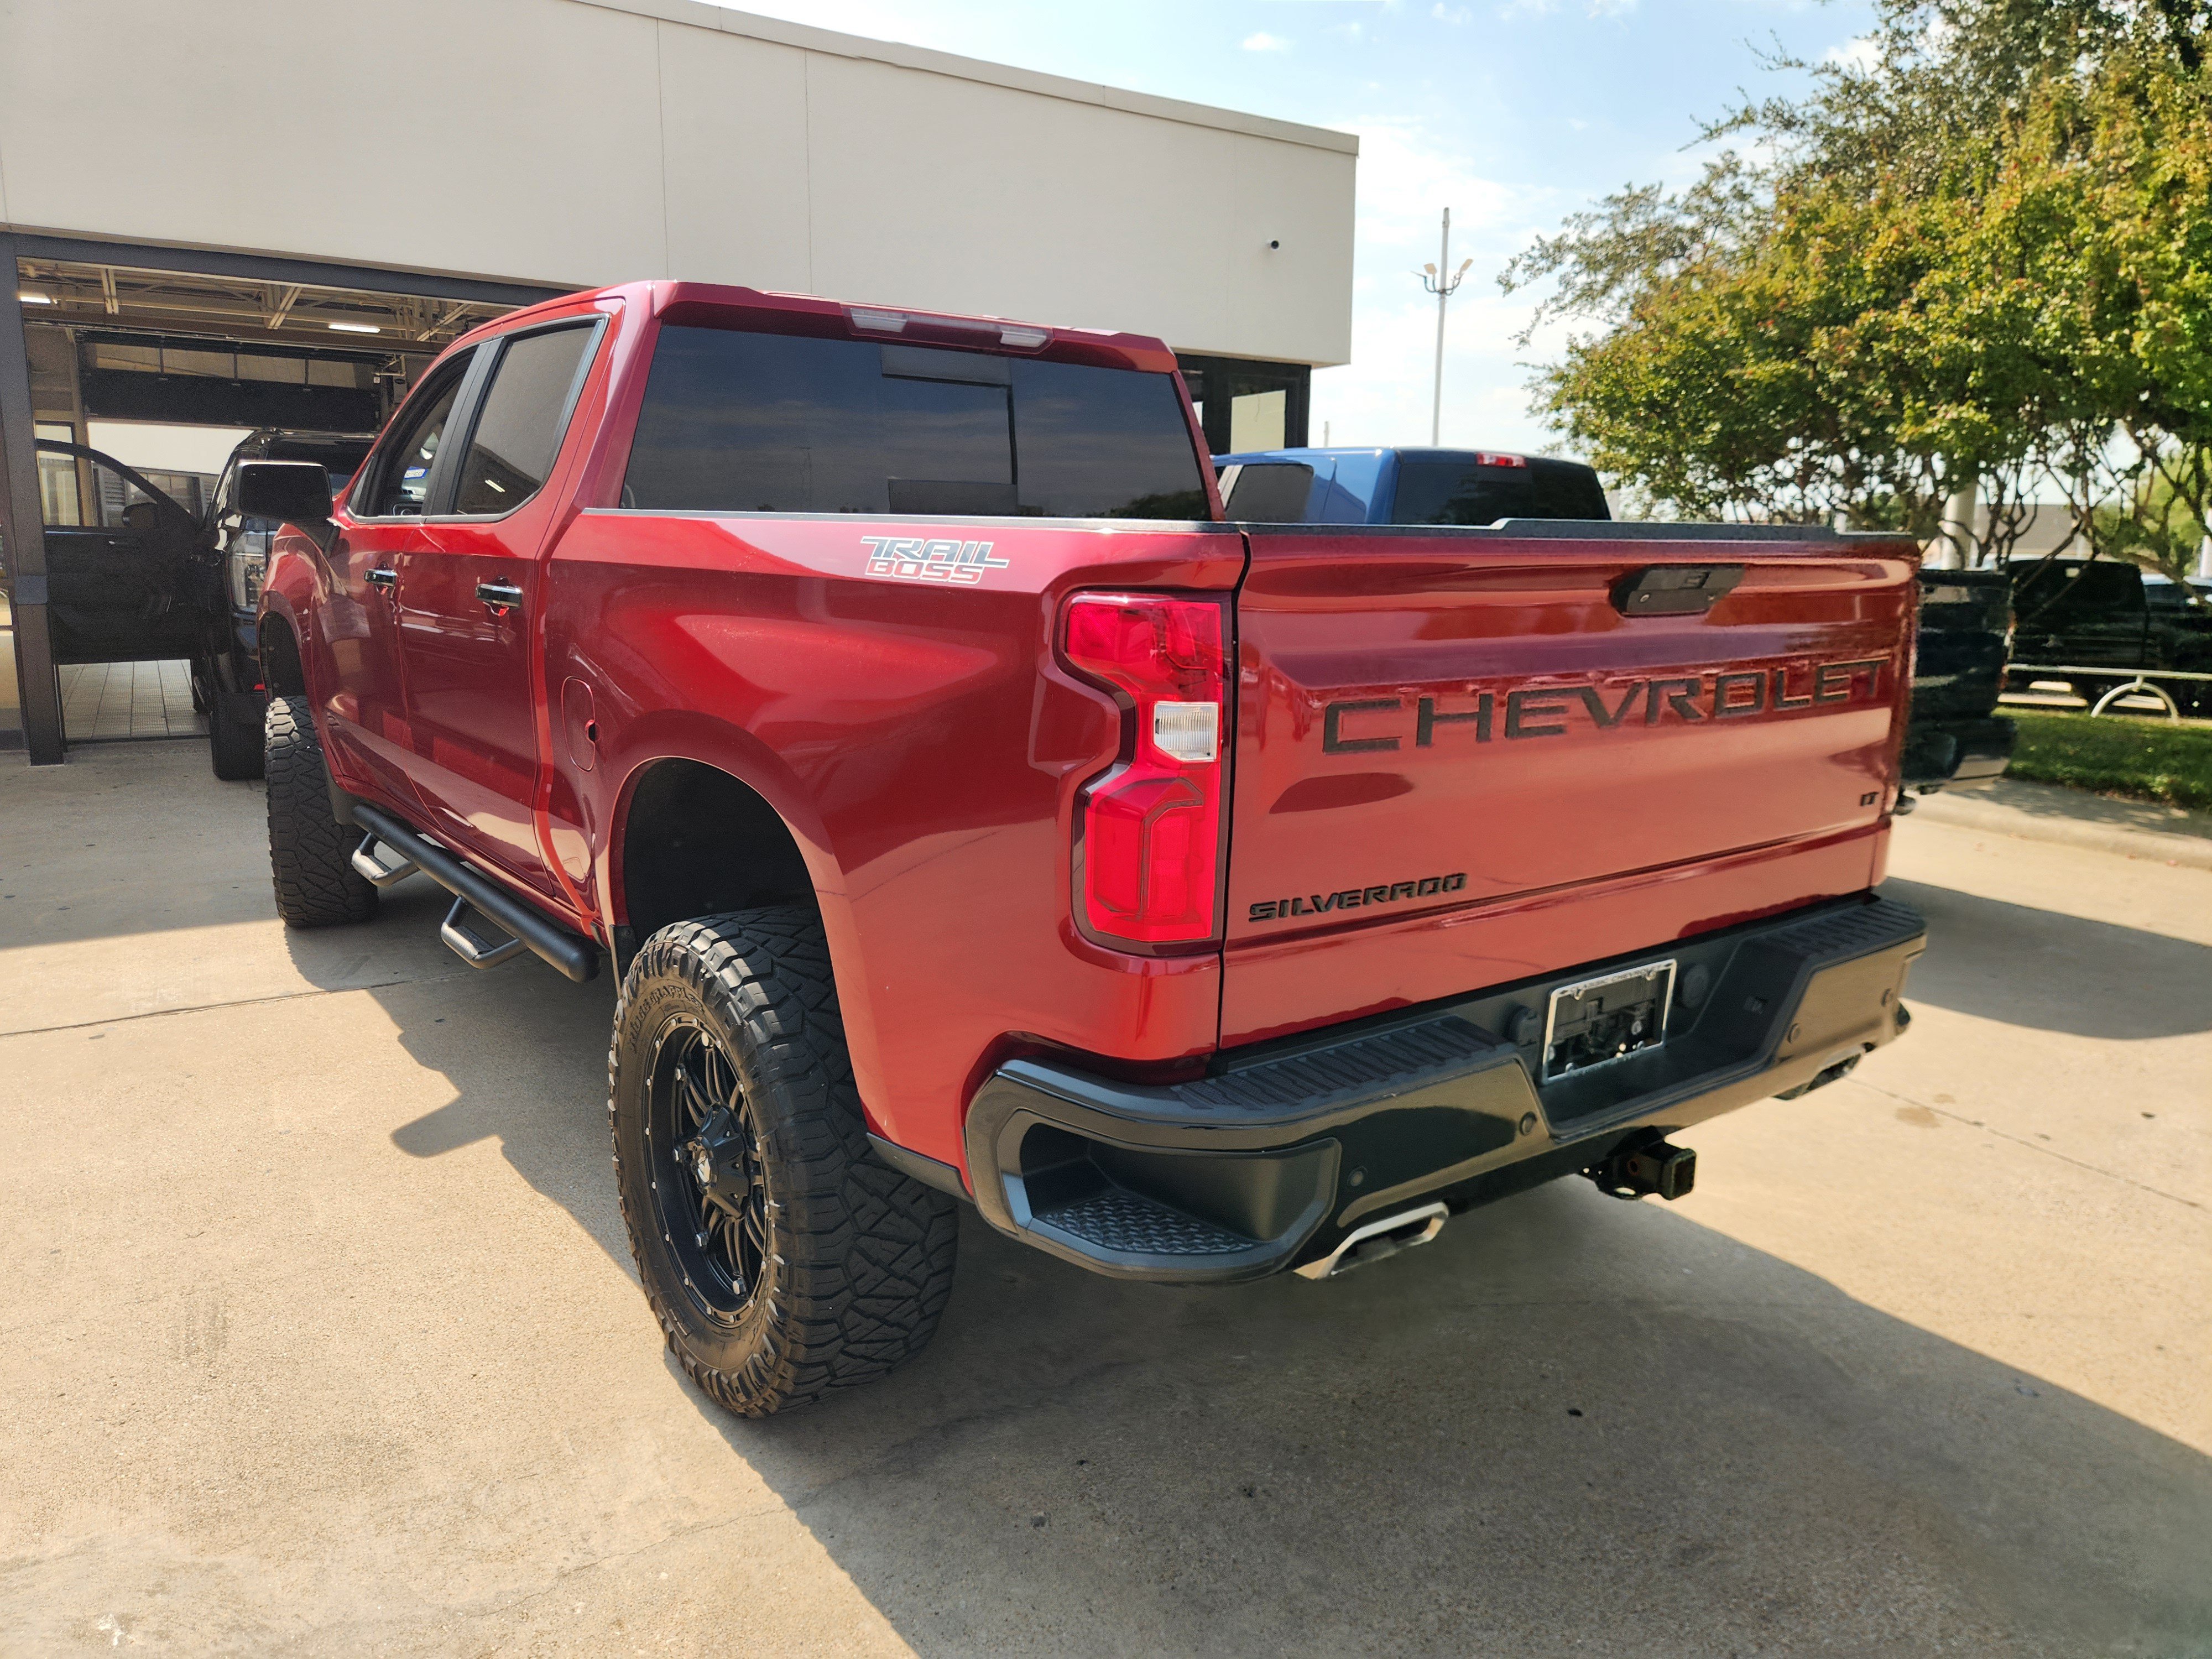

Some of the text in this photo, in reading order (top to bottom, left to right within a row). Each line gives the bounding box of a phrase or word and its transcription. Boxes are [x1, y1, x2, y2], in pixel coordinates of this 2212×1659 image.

[860, 536, 1010, 568] TRAIL
[865, 559, 984, 584] BOSS
[1322, 656, 1888, 754] CHEVROLET
[1860, 791, 1879, 806] LT
[1249, 872, 1467, 922] SILVERADO
